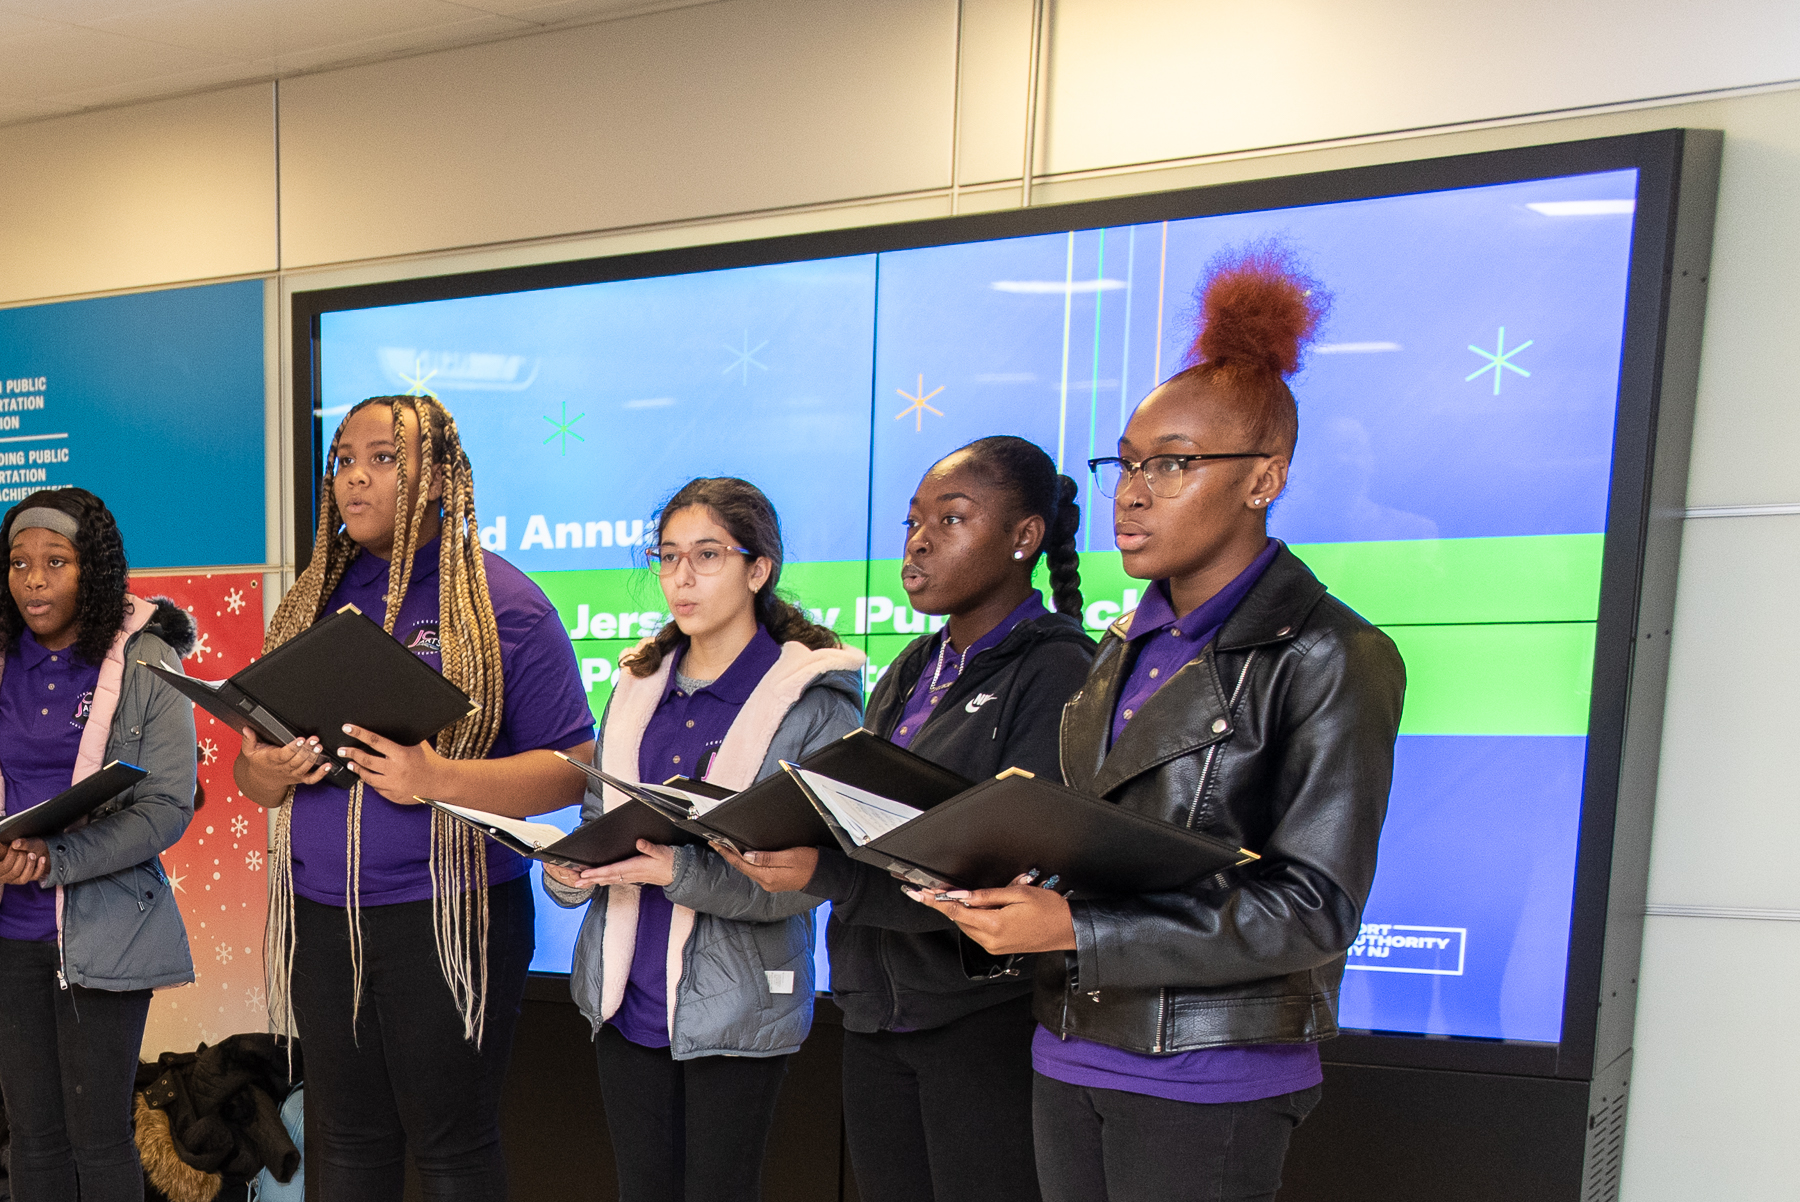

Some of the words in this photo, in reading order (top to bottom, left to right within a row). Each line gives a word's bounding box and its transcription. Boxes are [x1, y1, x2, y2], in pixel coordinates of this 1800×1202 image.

[6, 376, 47, 394] PUBLIC
[29, 448, 69, 465] PUBLIC
[519, 514, 660, 550] Annu
[570, 604, 671, 639] Jers
[1353, 935, 1450, 950] UTHORITY
[1367, 946, 1390, 958] NJ
